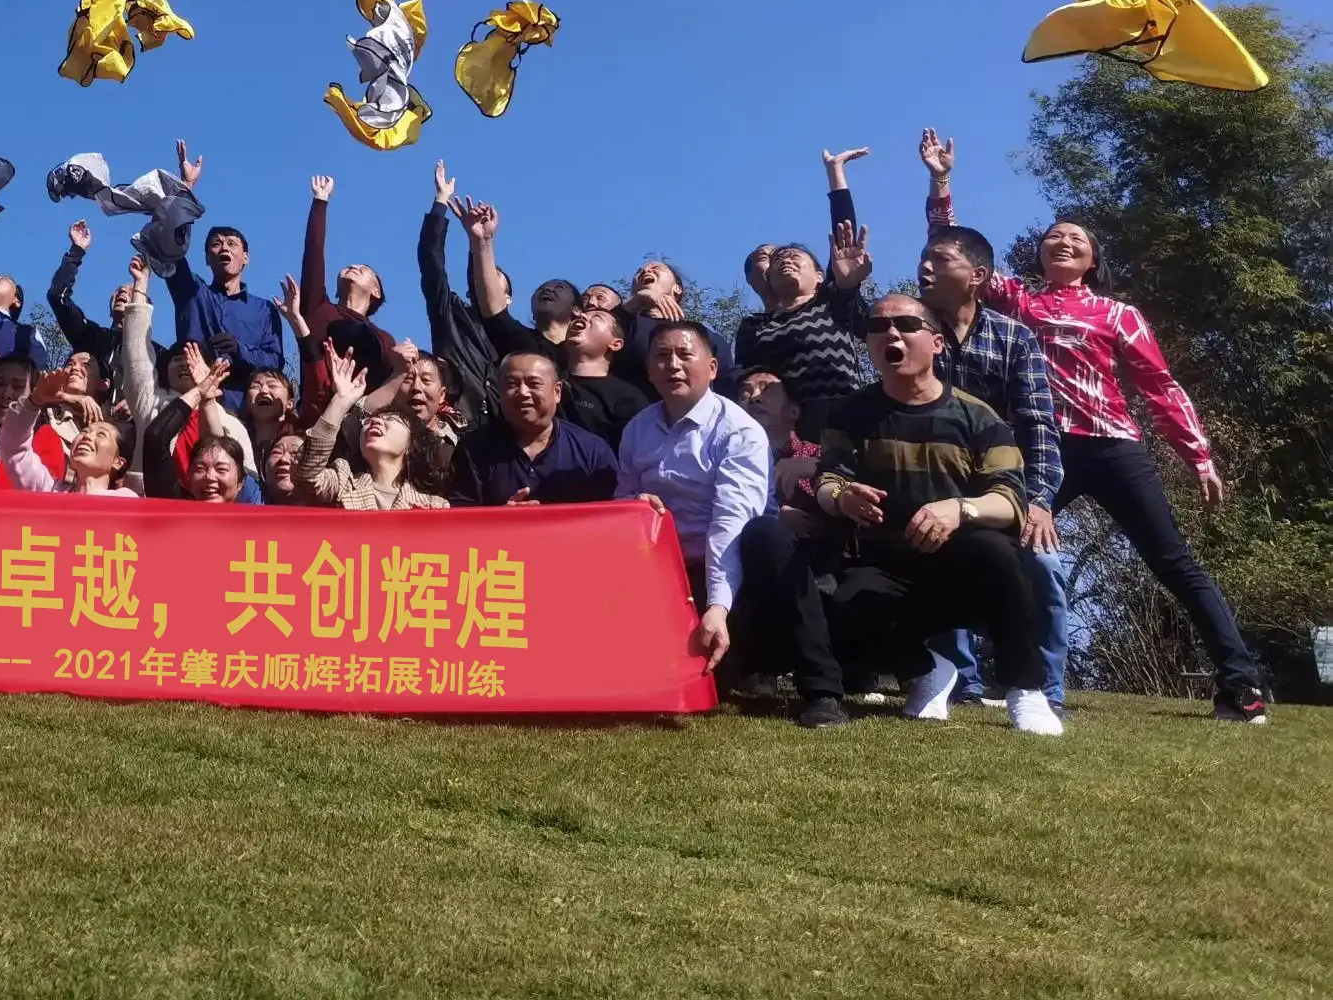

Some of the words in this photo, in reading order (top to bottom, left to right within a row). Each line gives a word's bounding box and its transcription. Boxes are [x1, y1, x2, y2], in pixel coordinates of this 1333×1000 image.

[53, 645, 507, 699] 2021年肇庆顺辉拓展训练
